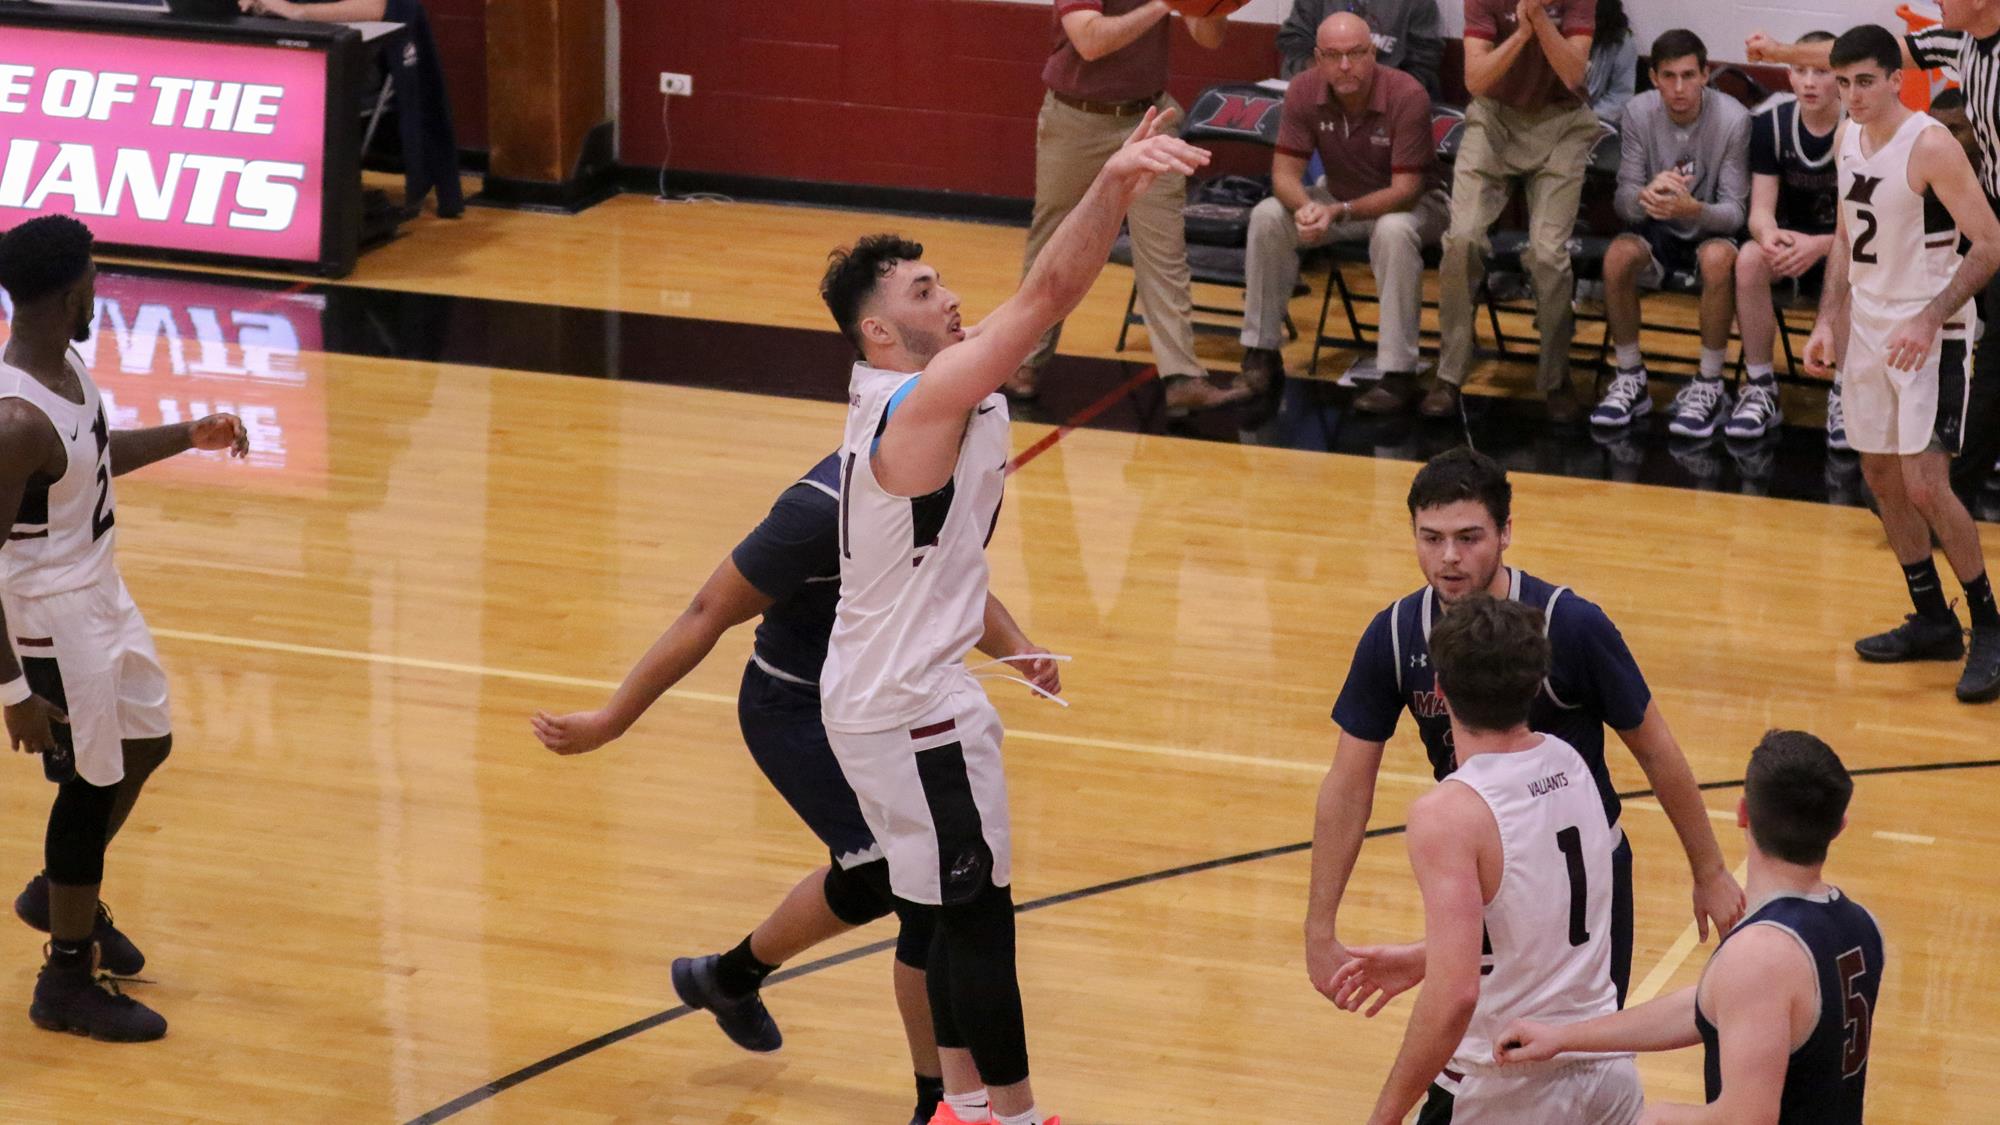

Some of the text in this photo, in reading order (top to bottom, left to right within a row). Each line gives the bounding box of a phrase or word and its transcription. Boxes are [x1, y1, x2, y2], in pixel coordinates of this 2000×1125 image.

[0, 63, 284, 134] E OF THE
[0, 138, 305, 232] IANTS
[1852, 209, 1878, 264] 2
[92, 463, 115, 543] 2
[1527, 771, 1569, 798] VALIANTS
[1556, 826, 1590, 947] 1
[1835, 945, 1869, 1080] 5
